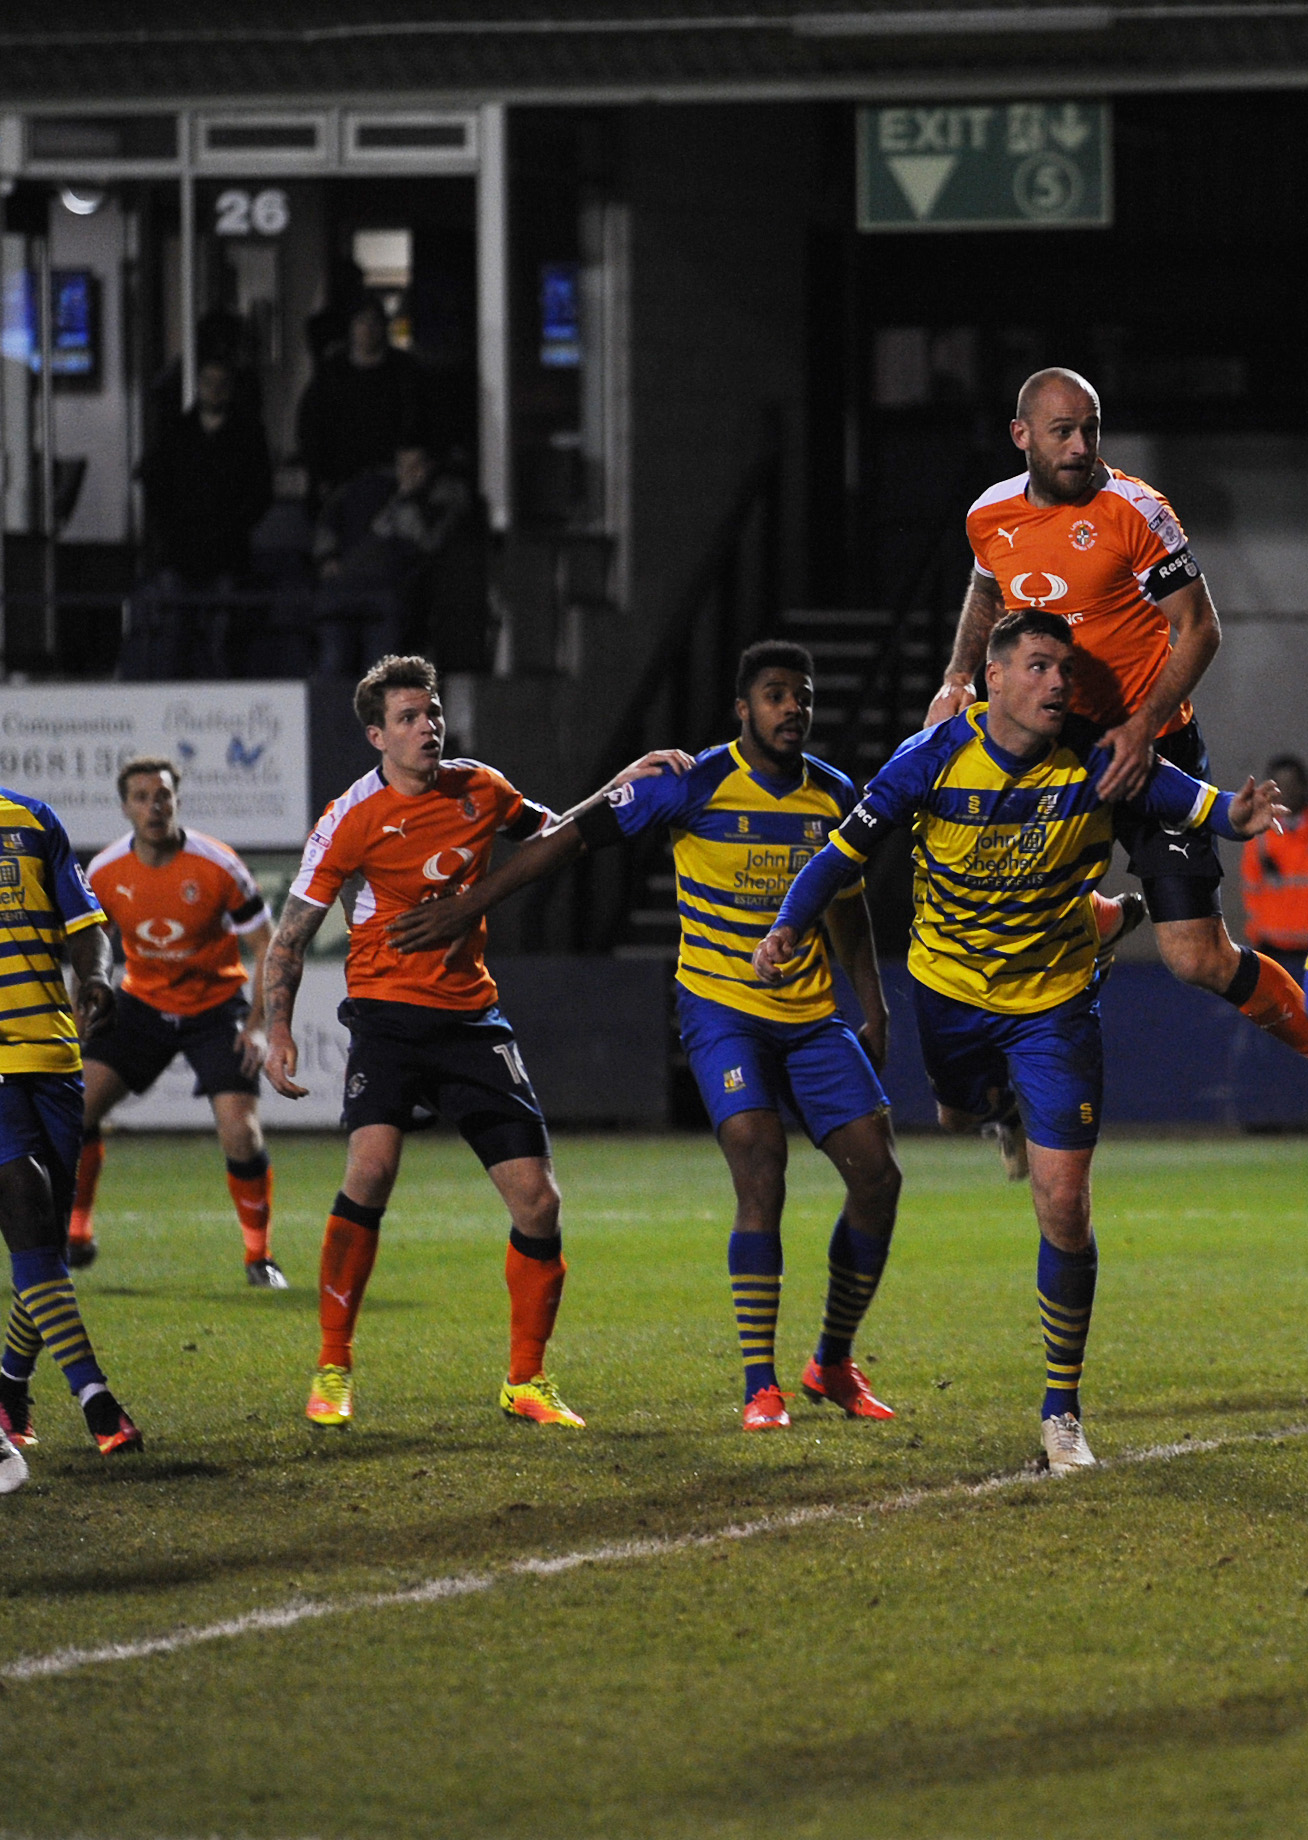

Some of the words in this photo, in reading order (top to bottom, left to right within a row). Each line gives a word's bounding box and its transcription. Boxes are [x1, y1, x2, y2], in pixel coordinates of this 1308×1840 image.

[878, 107, 994, 150] EXIT
[216, 190, 289, 235] 26
[744, 849, 786, 871] John
